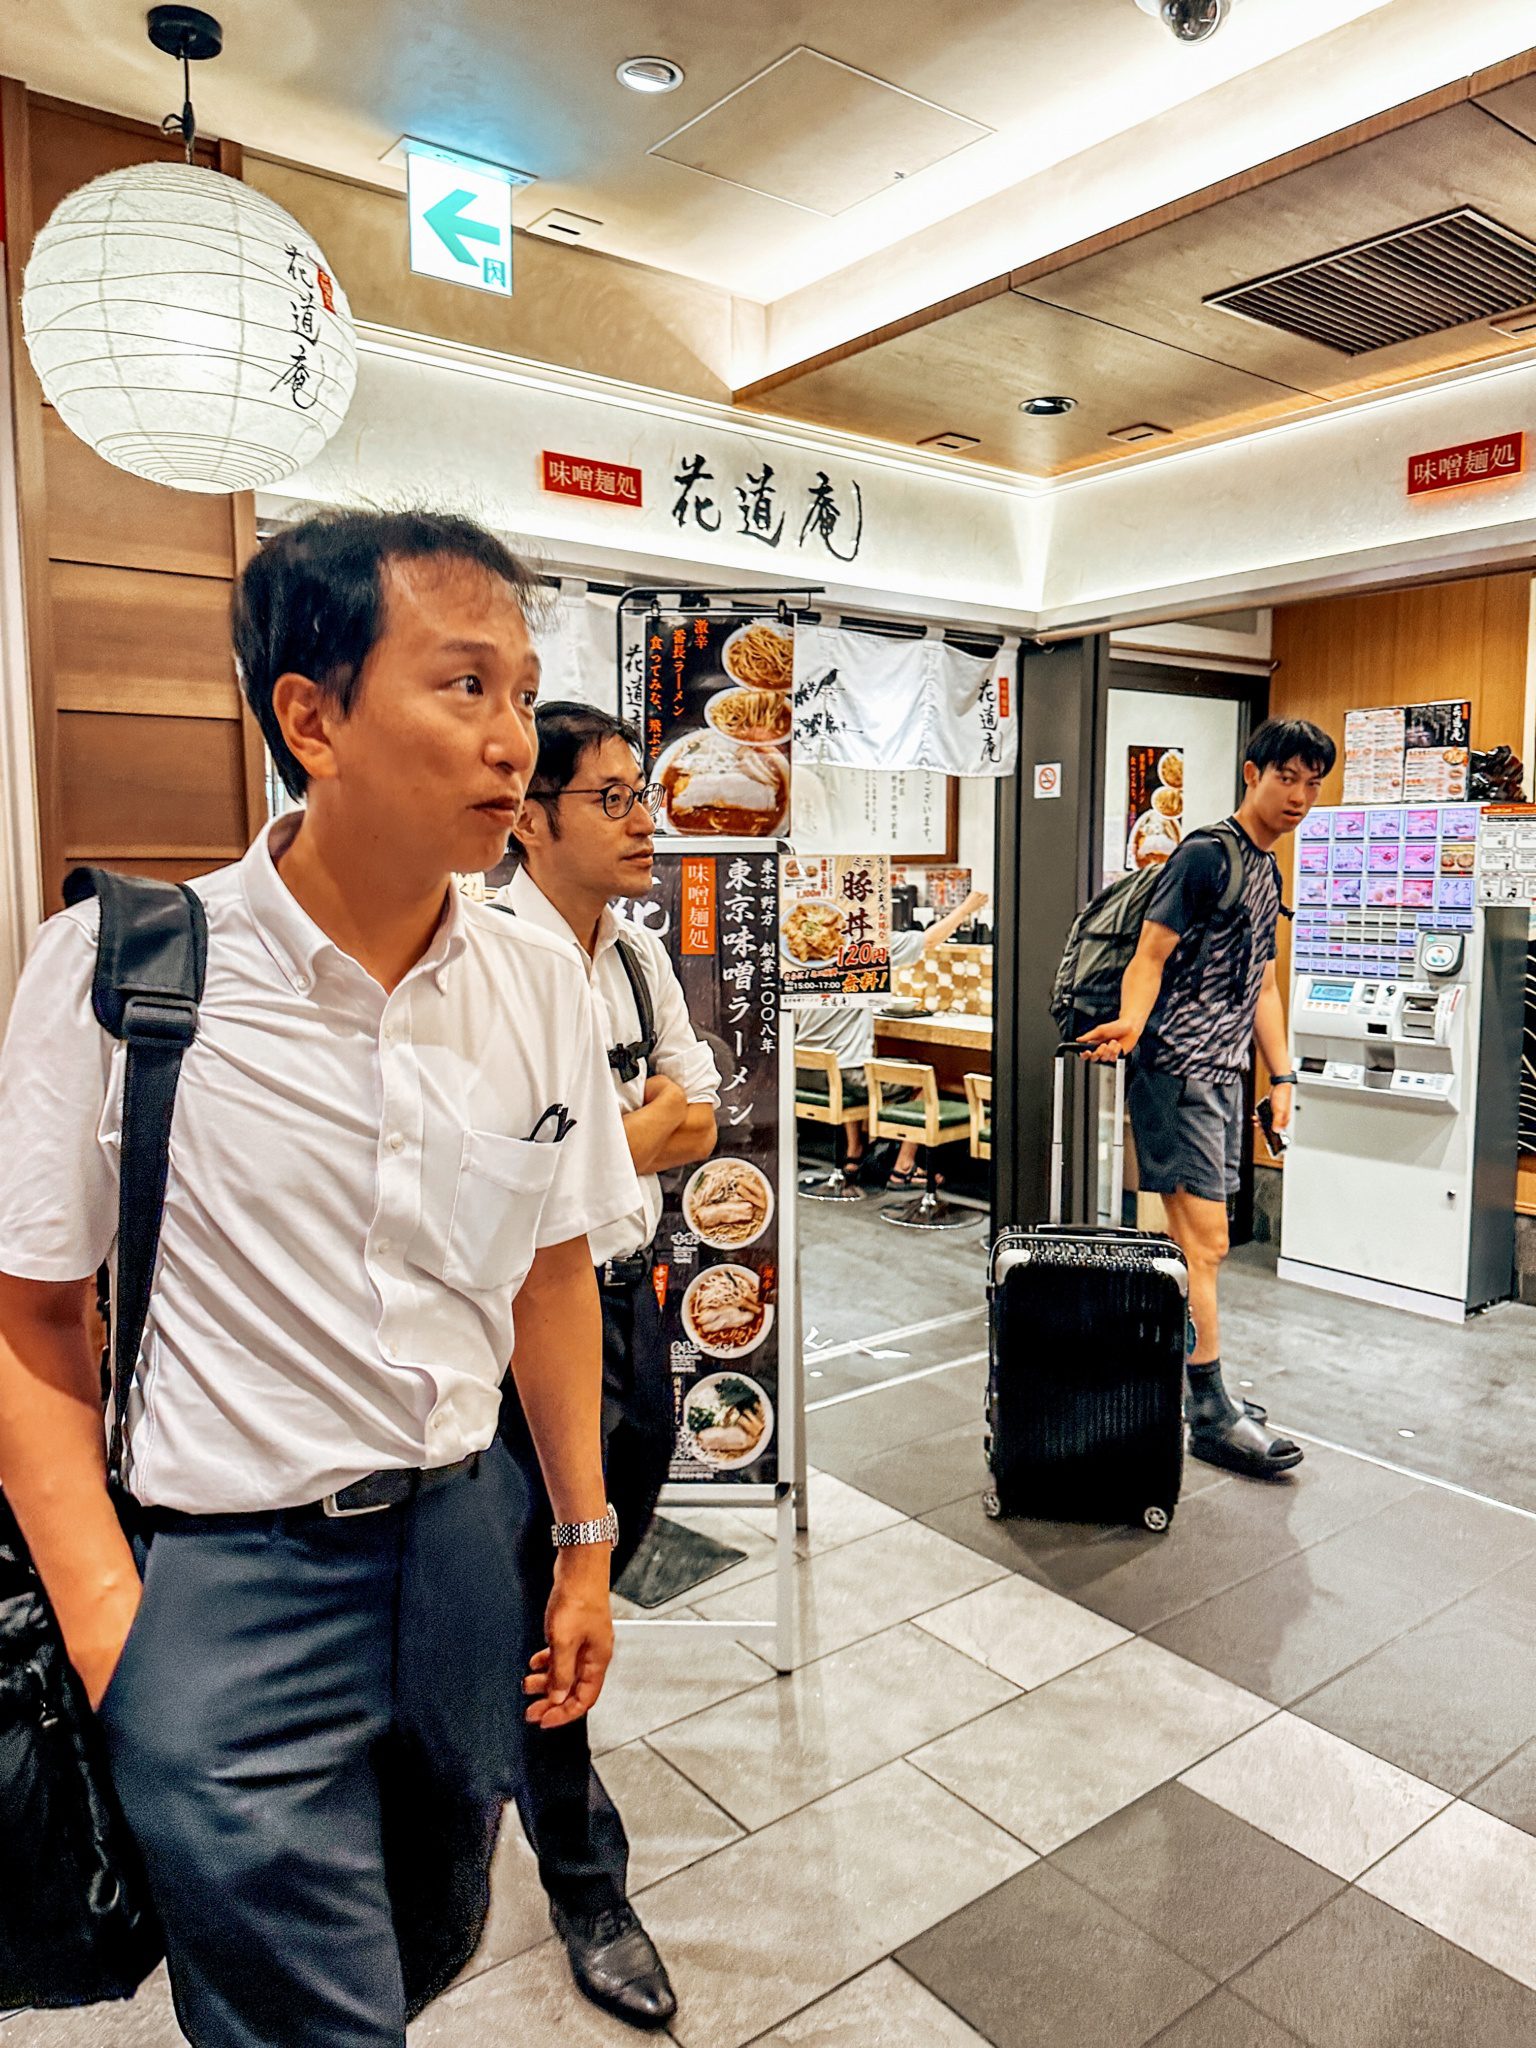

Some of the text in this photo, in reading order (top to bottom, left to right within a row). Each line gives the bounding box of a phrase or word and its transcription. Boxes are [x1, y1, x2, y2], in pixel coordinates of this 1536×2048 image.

[270, 243, 325, 409] 花道庵
[549, 461, 637, 499] 味噌麺処
[1414, 443, 1516, 485] 味噌麺処
[672, 454, 862, 562] 花道庵
[672, 629, 687, 716] 番長ラーメン
[688, 863, 709, 949] 味噌麺処
[760, 858, 776, 889] 東京
[841, 870, 874, 942] 豚丼
[760, 896, 776, 926] 野方
[837, 943, 887, 967] 120円
[723, 857, 757, 1126] 東京味噌ラーメン
